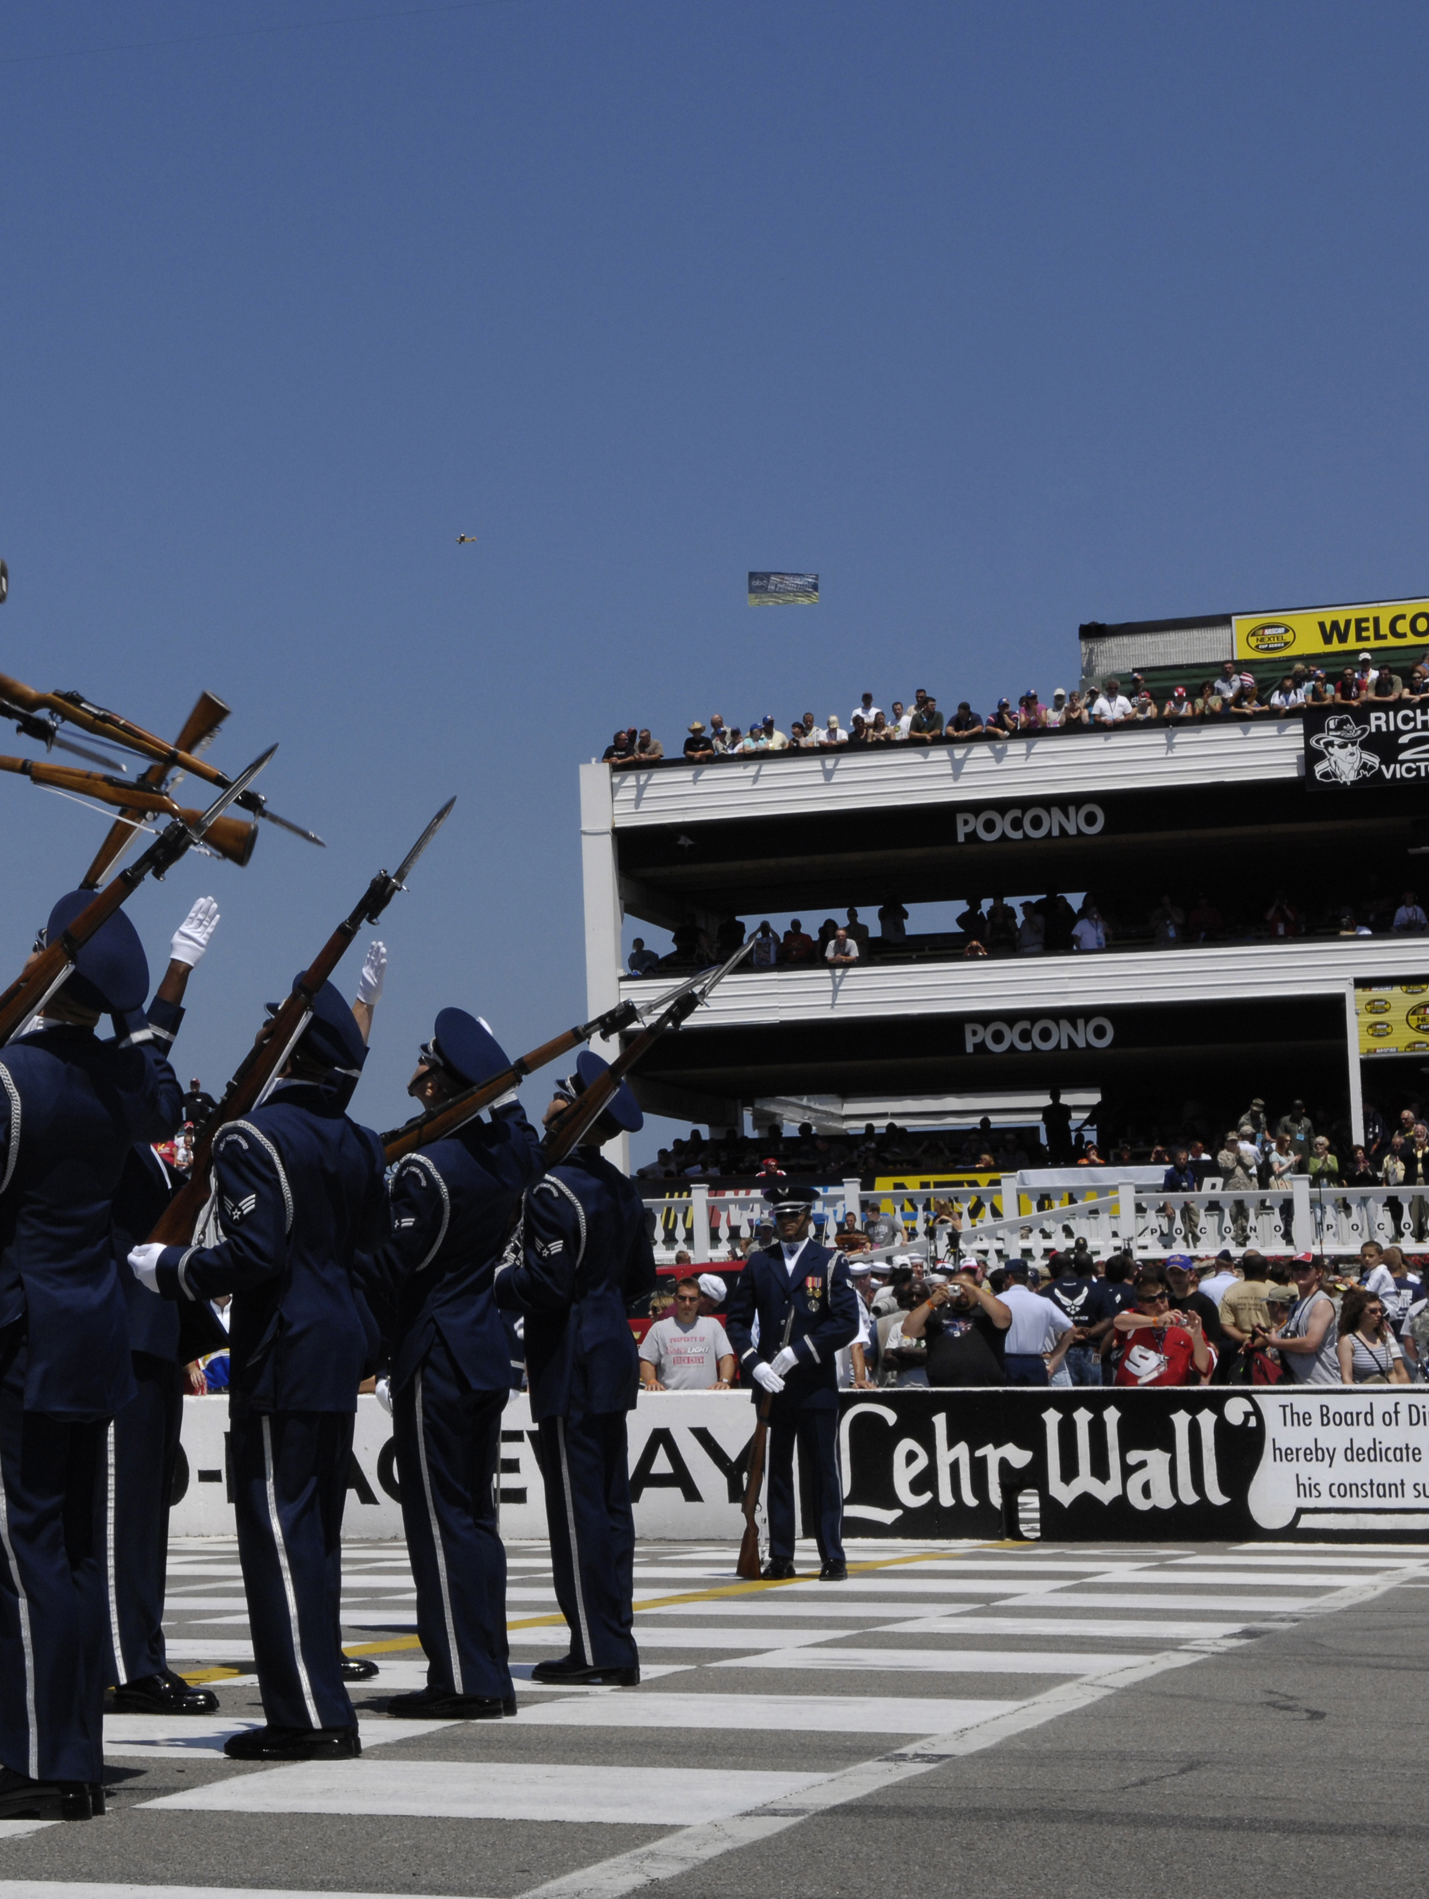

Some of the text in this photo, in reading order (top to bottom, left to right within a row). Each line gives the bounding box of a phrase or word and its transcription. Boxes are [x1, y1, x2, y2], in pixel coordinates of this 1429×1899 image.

[1256, 635, 1286, 643] NEXTEL
[1317, 611, 1429, 646] WELCO
[1380, 762, 1429, 779] VICT
[956, 803, 1105, 843] POCONO
[964, 1016, 1115, 1053] POCONO
[687, 1346, 711, 1354] LIGHT
[1279, 1402, 1429, 1427] The Board of Di
[841, 1403, 1033, 1524] Lehr
[1040, 1405, 1231, 1511] Wall
[1272, 1437, 1422, 1468] hereby dedicate
[1295, 1473, 1322, 1499] his
[1328, 1478, 1406, 1499] constant
